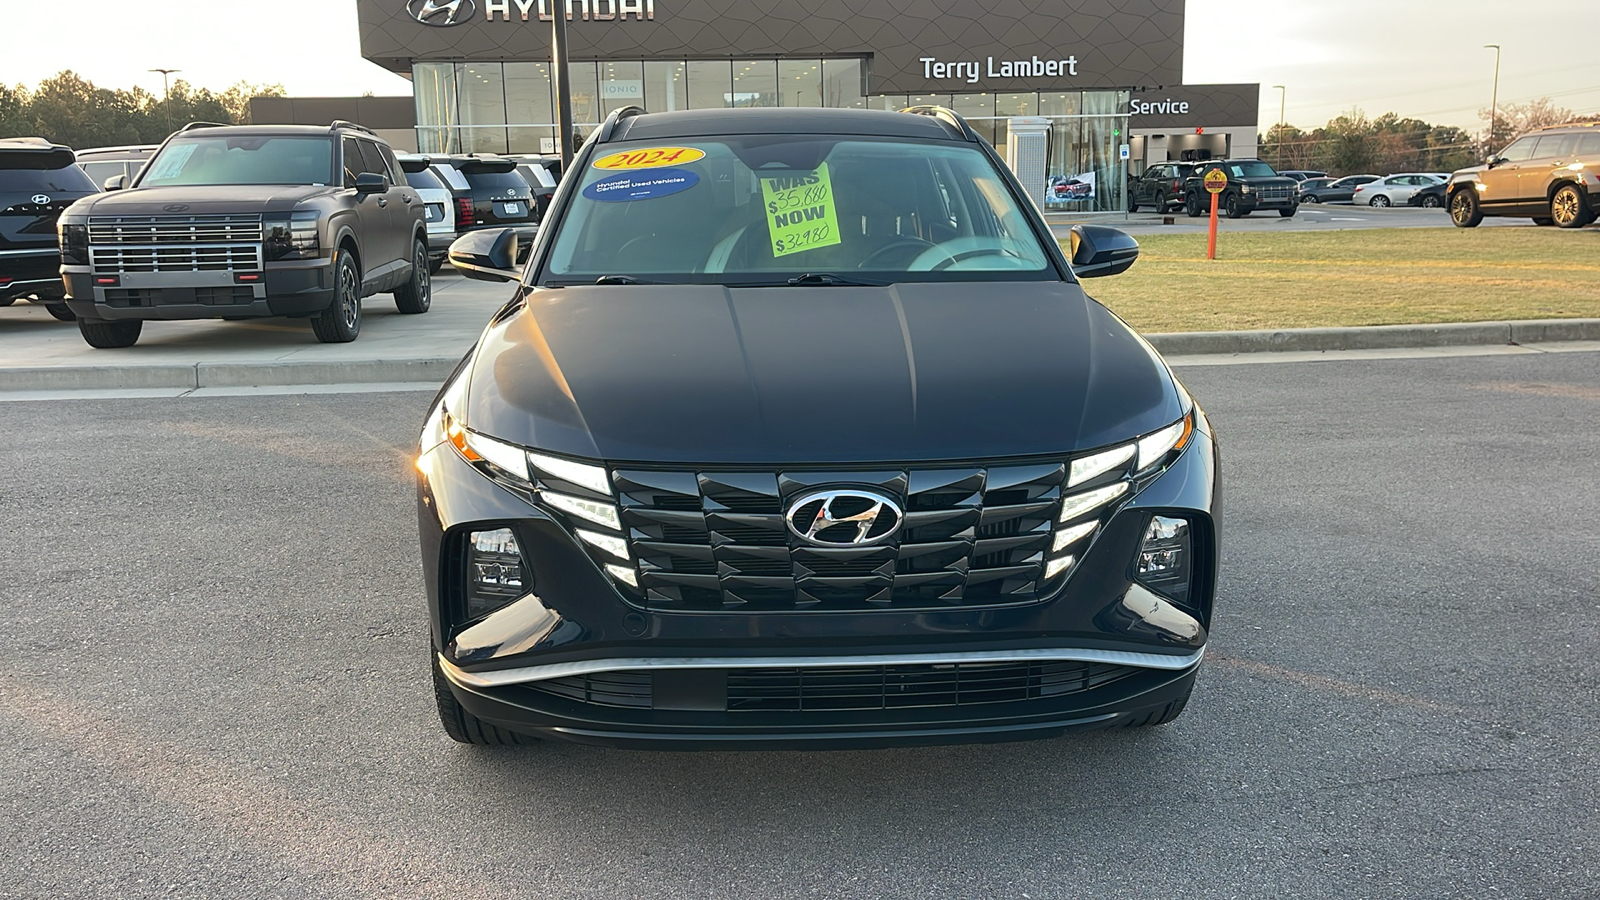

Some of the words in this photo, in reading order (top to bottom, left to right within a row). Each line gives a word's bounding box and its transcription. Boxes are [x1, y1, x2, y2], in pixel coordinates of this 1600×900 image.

[919, 57, 979, 84] Terry
[987, 55, 1078, 78] Lambert
[605, 85, 637, 93] IONIQ
[1130, 98, 1189, 115] Service
[607, 149, 686, 168] 2024
[596, 179, 631, 188] Hyundai
[596, 183, 630, 193] Certified
[631, 180, 652, 188] Used
[652, 177, 685, 185] Vehicles
[769, 171, 821, 193] WAS
[774, 205, 825, 229] NOW
